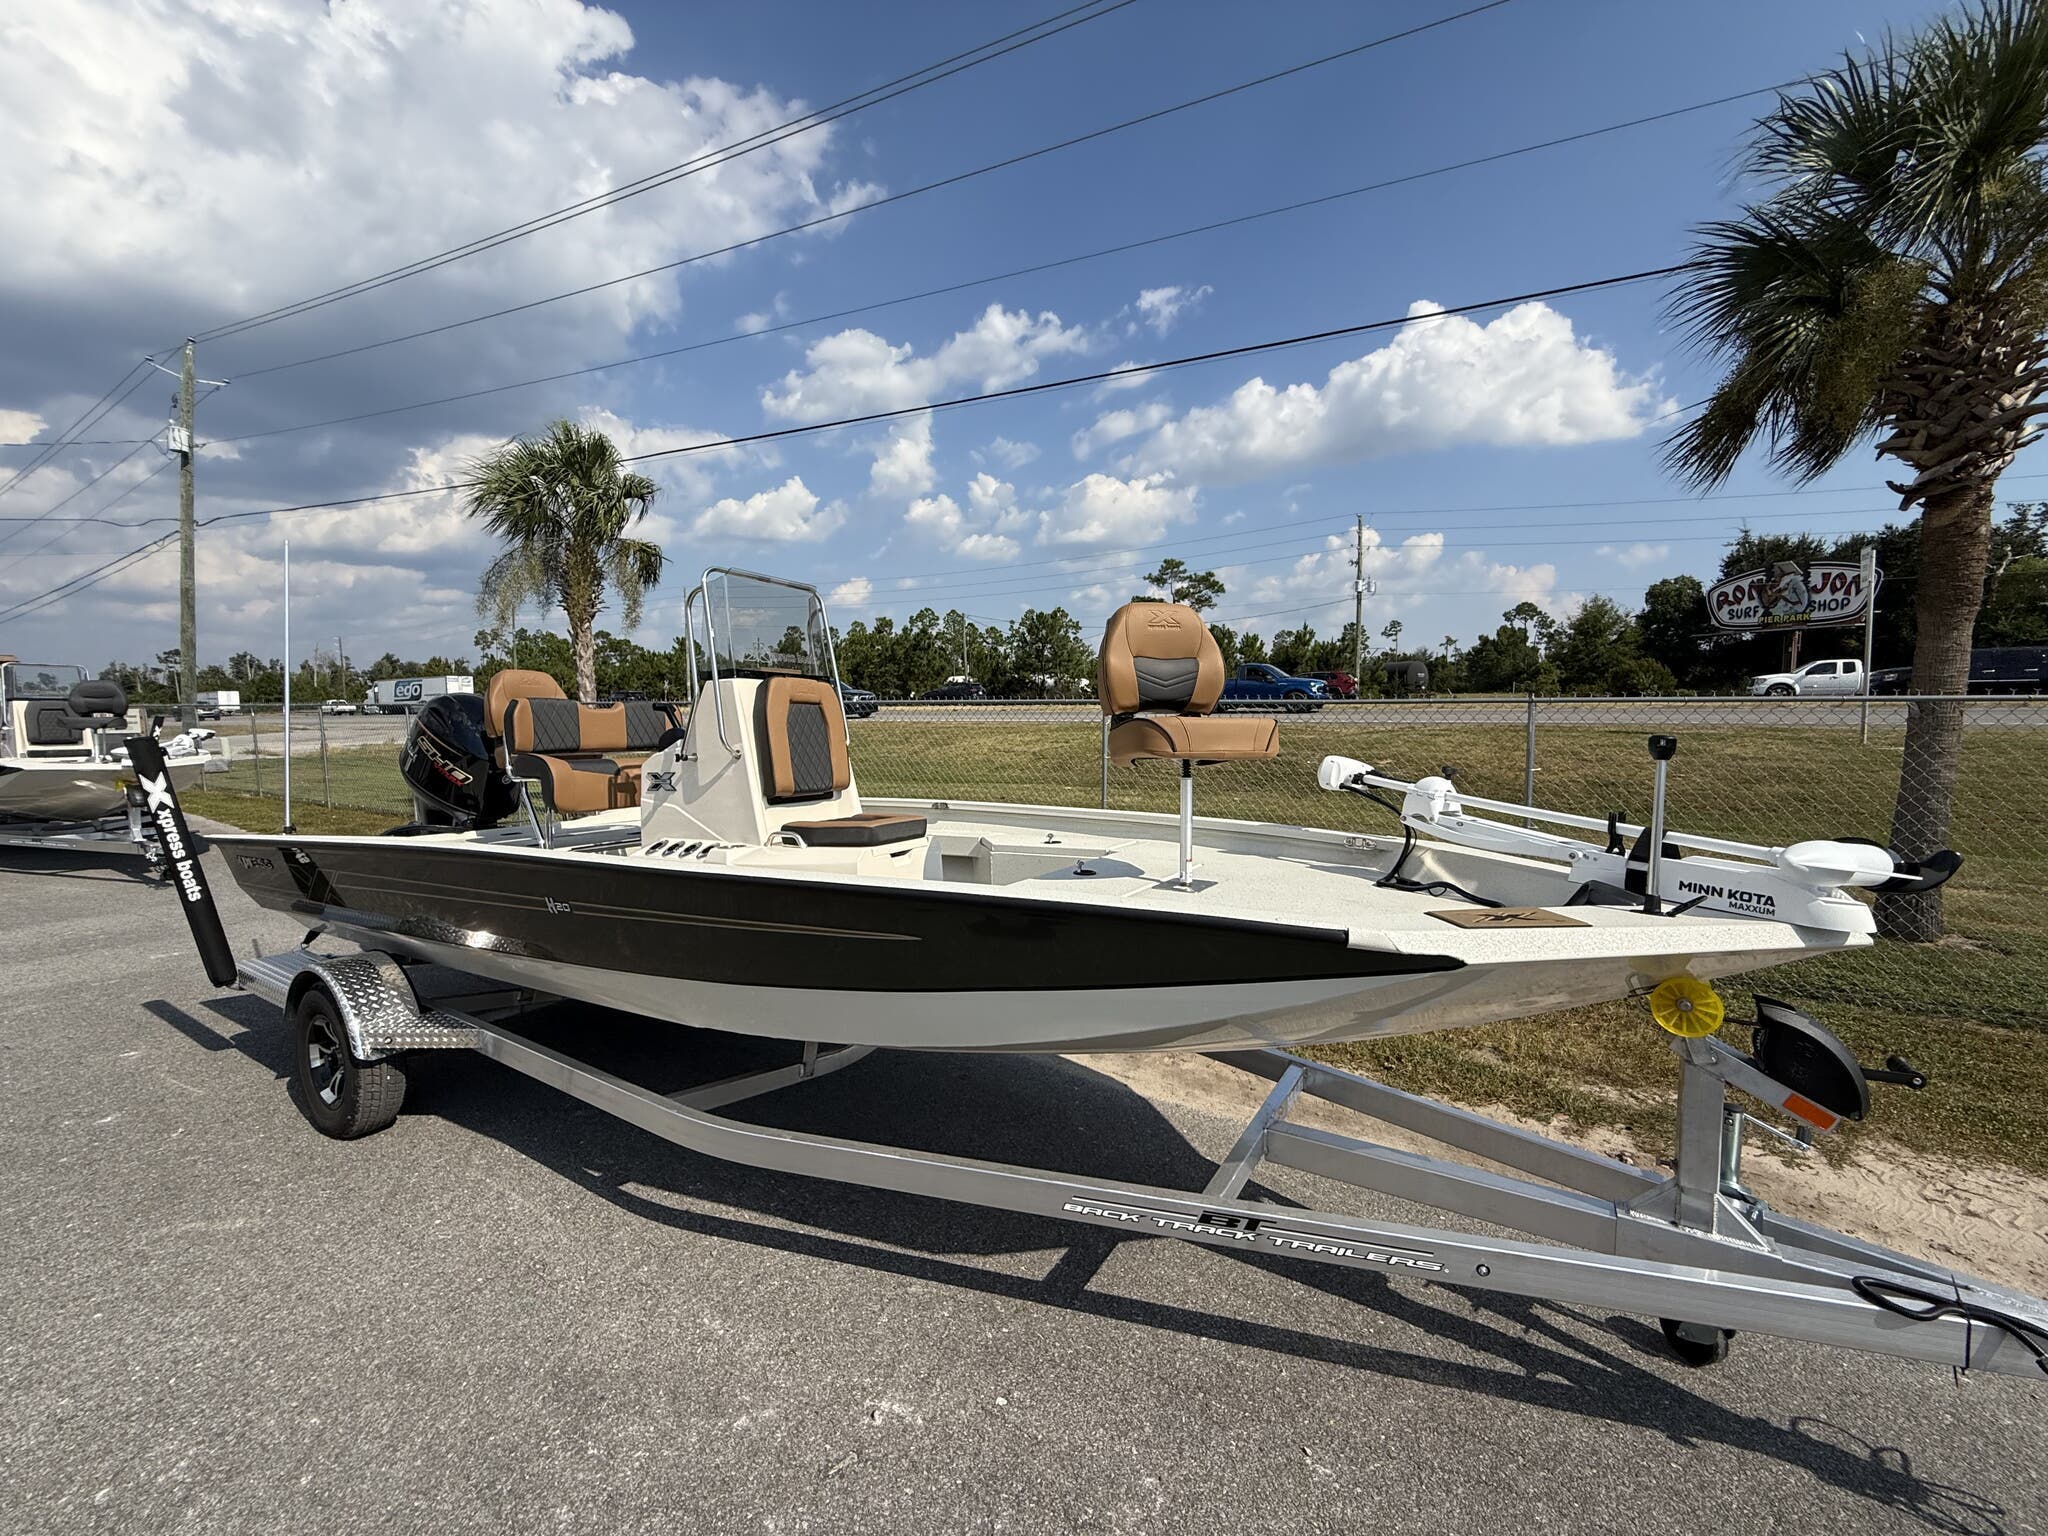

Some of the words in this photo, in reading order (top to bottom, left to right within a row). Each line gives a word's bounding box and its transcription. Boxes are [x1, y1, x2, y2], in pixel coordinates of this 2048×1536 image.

[1717, 579, 1765, 612] RON
[1811, 572, 1862, 597] JON
[1728, 605, 1760, 620] SURF
[1809, 597, 1850, 612] SHOP
[1758, 615, 1780, 625] PIER
[1782, 612, 1811, 624] PARK
[157, 808, 186, 859] xpress
[175, 860, 202, 902] boats
[1678, 880, 1724, 898] MINN
[1727, 888, 1776, 908] KOTA
[1728, 901, 1776, 916] MAXXUM
[1062, 1202, 1144, 1224] BACK
[1150, 1216, 1261, 1242] TRACK
[1268, 1235, 1445, 1273] TRAILERS
